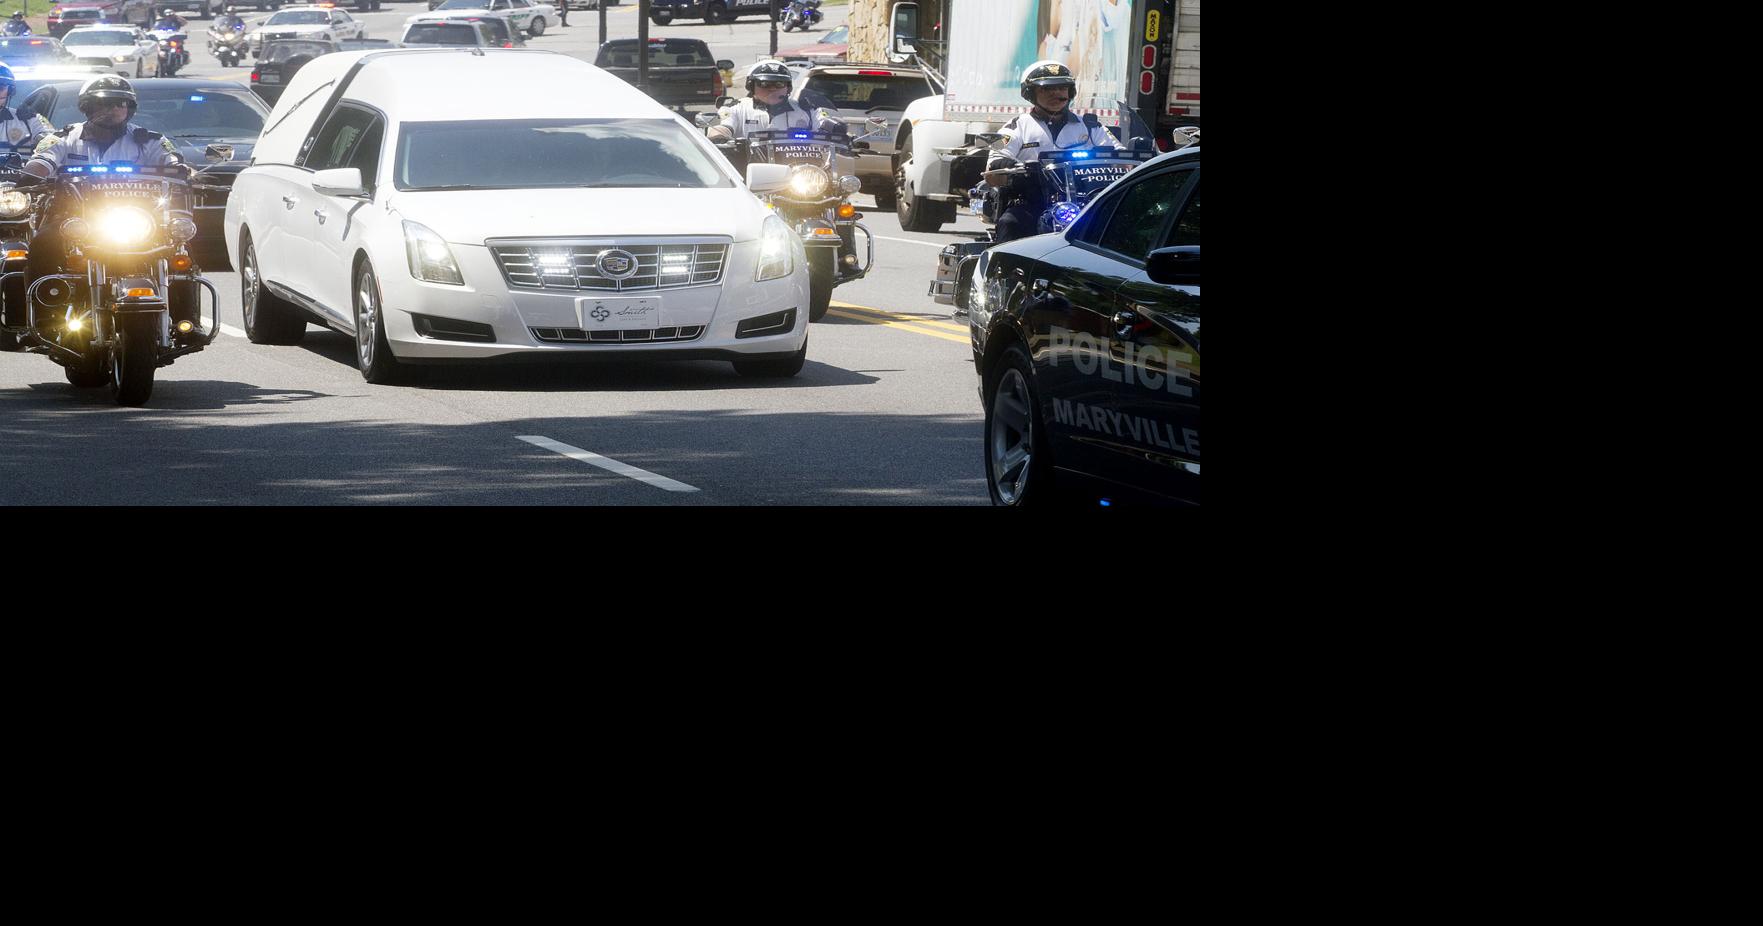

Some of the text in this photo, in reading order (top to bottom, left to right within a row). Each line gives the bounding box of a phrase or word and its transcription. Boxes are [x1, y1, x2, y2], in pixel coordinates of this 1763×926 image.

[1074, 162, 1132, 175] MARYVILL
[91, 182, 161, 191] MARYVILLE
[104, 190, 150, 198] POLICE
[1049, 325, 1193, 397] POLICE
[1052, 397, 1200, 456] MARYVILLE
